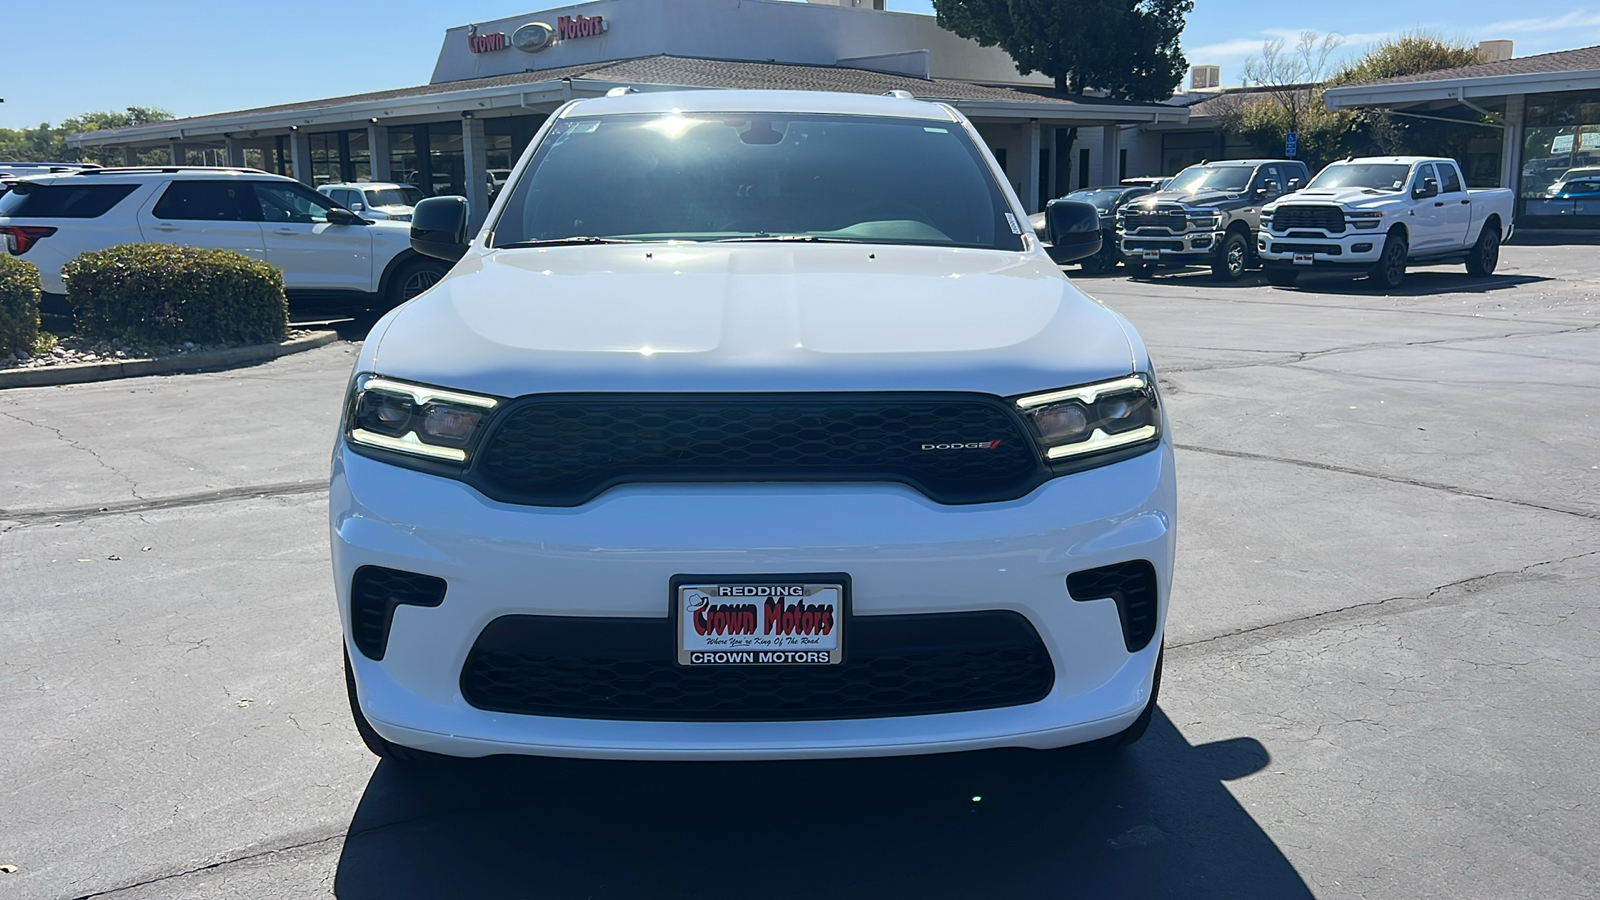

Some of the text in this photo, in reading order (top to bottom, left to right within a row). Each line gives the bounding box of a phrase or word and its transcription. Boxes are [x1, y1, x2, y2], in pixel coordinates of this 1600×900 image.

[468, 15, 603, 53] Crown Motors
[921, 441, 992, 450] DODGE
[719, 586, 803, 596] REDDING
[693, 597, 834, 636] Crown Motors
[706, 637, 819, 647] Where You're King Of The Road
[691, 652, 829, 664] CROWN MOTORS
